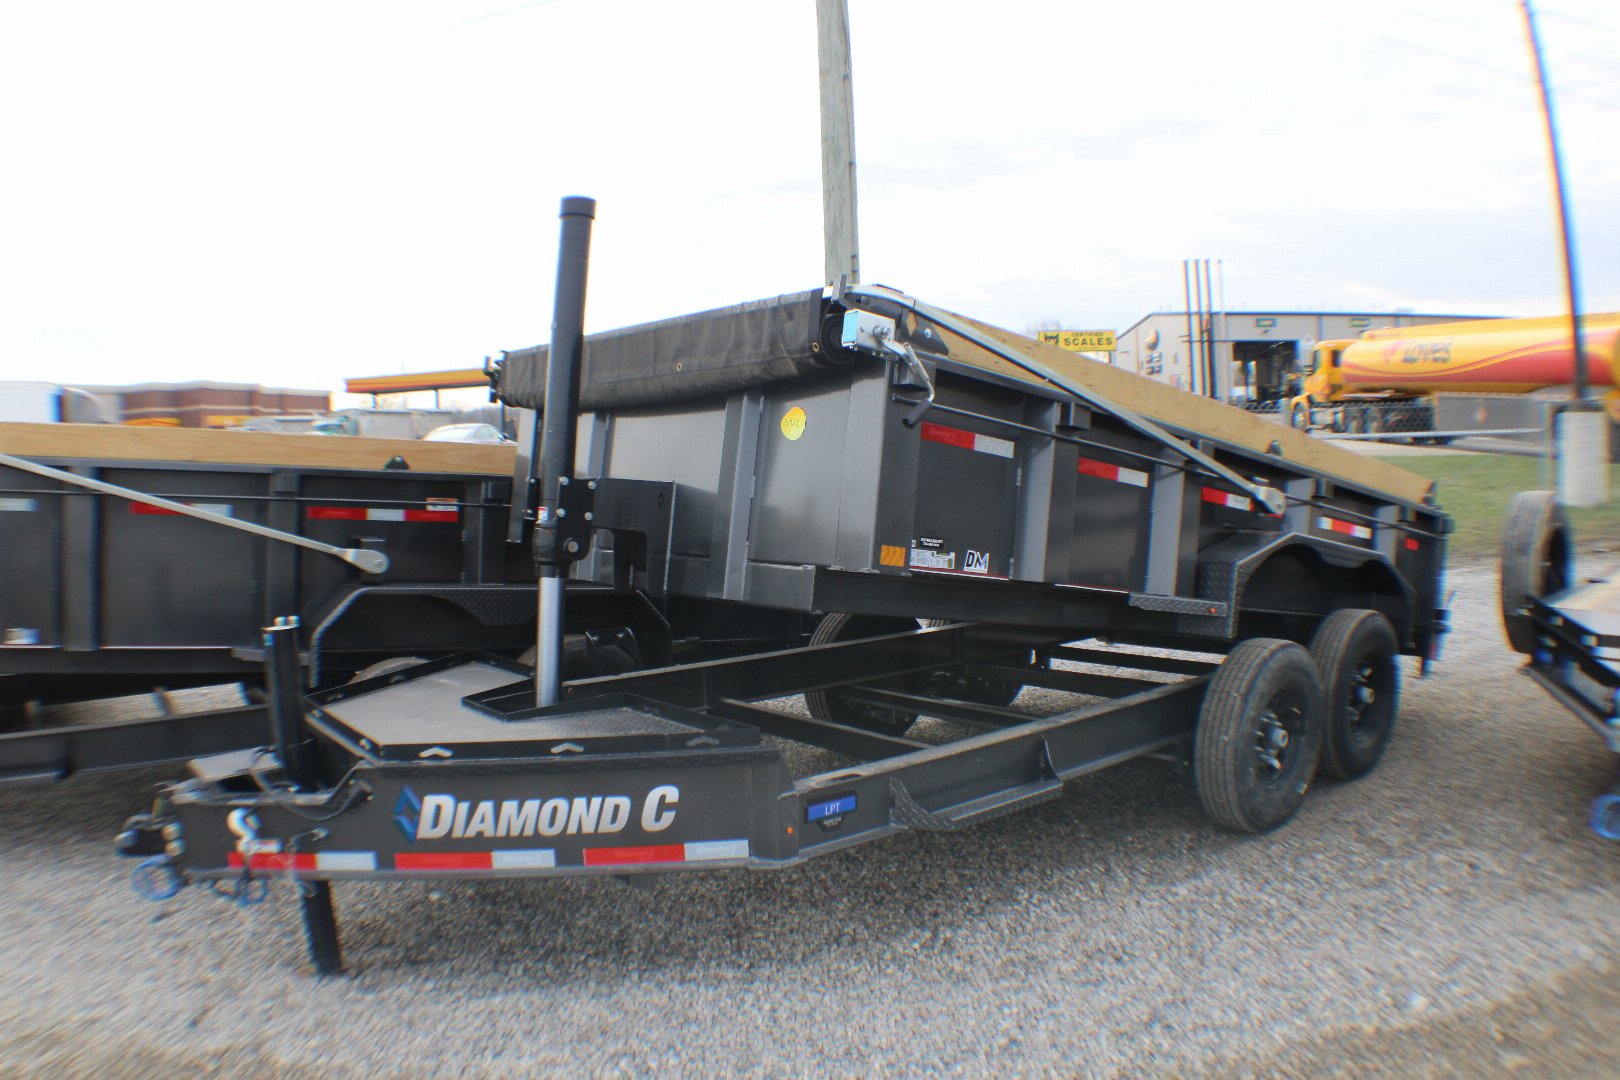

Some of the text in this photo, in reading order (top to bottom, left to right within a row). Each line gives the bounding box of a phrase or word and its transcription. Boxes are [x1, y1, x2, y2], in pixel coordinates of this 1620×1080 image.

[1064, 337, 1113, 346] SCALES
[965, 550, 988, 570] DM
[641, 785, 680, 832] C
[825, 802, 841, 816] LPT
